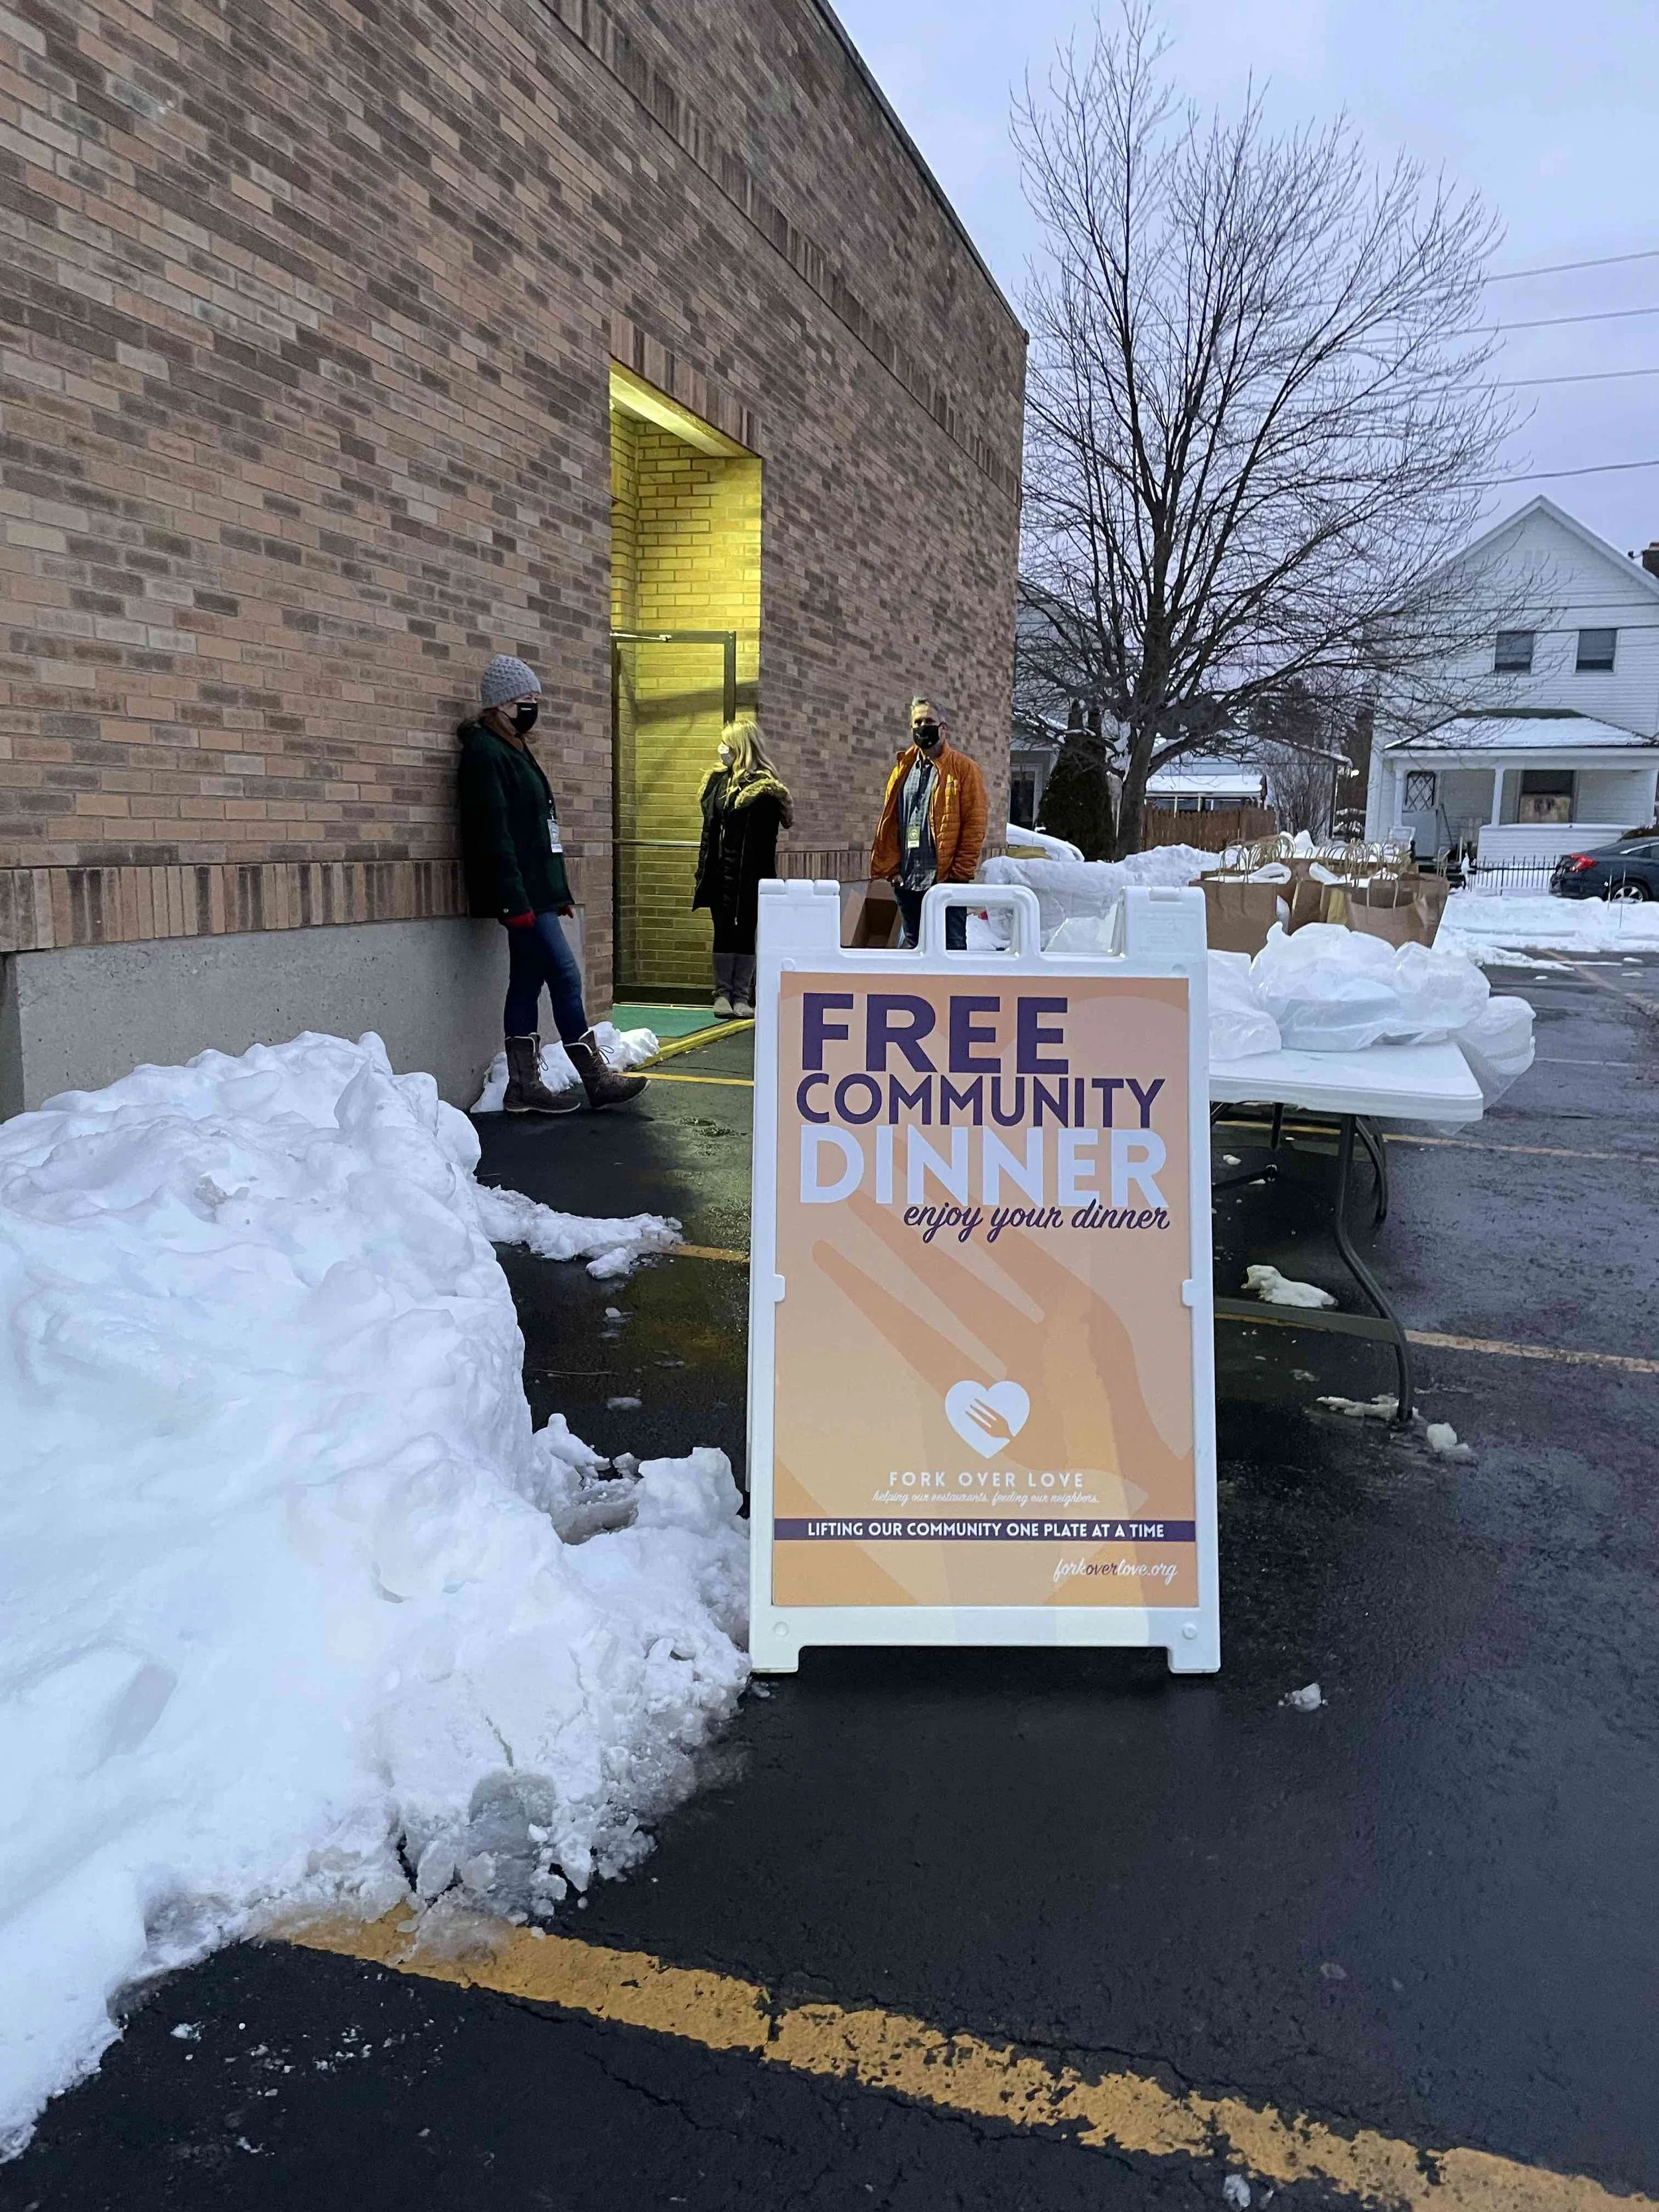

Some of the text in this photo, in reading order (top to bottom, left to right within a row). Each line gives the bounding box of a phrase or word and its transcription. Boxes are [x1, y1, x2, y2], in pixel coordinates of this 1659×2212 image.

[802, 993, 1069, 1074] FREE
[796, 1073, 1165, 1128] COMMUNITY
[800, 1124, 1169, 1208] DINNER
[904, 1198, 1170, 1243] enjoy your dinner
[889, 1471, 1084, 1488] FORK OVER LOVE
[873, 1491, 909, 1507] helping
[992, 1493, 1029, 1507] feeding
[808, 1522, 1165, 1538] LIFTING OUR COMMUNITY ONE PLATE AT A TIME
[1052, 1558, 1177, 1585] forkoverlove.org
